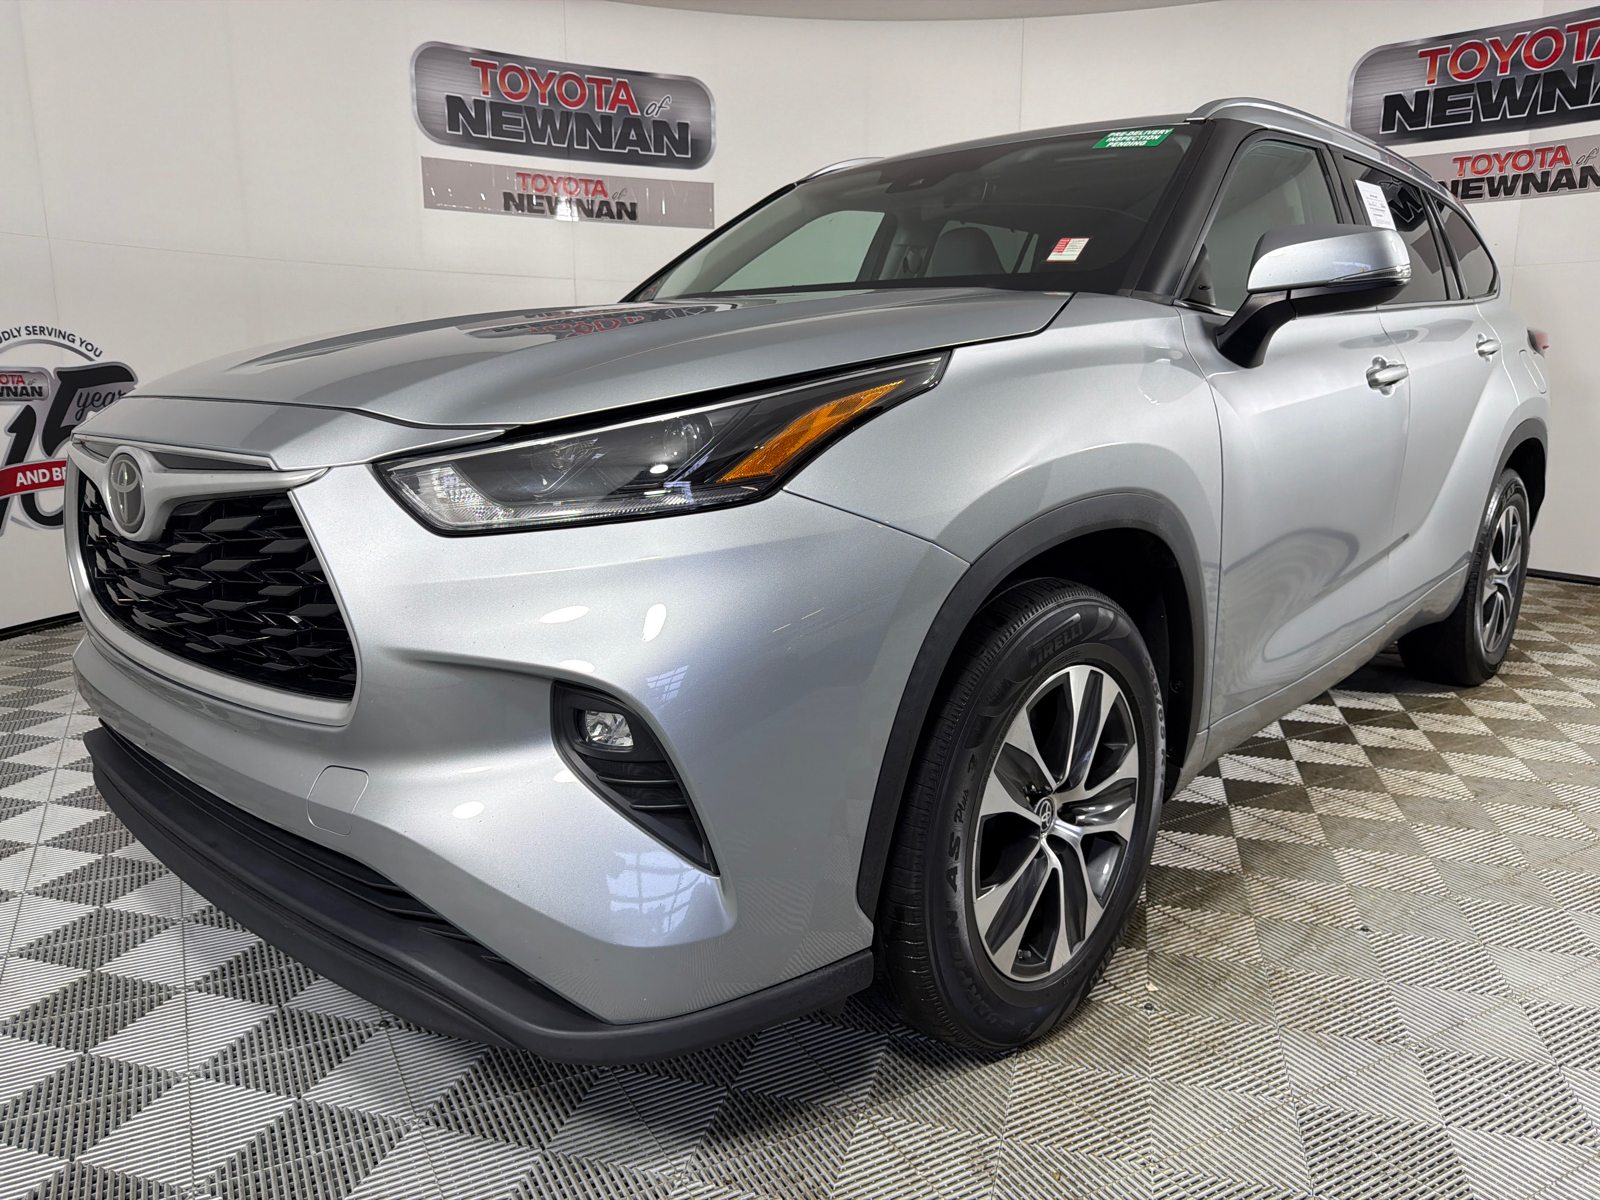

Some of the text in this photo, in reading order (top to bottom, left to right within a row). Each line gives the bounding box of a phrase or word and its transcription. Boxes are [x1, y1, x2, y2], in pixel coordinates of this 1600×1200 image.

[1417, 17, 1600, 87] TOYOT
[469, 57, 672, 119] TOYOTA of
[1379, 63, 1600, 135] NEWN
[445, 93, 693, 158] NEWNAN
[1105, 134, 1162, 143] INSPECTION
[1107, 128, 1171, 138] PRE-DELIVERY
[1105, 140, 1148, 148] PENDING
[1453, 145, 1599, 177] TOYOTA of
[515, 172, 628, 200] TOYOTA of
[24, 325, 76, 344] SERVING
[78, 337, 103, 358] YOU
[27, 378, 37, 386] of
[16, 468, 51, 487] AND
[1025, 613, 1084, 669] PIRELLI
[947, 833, 961, 893] AS
[954, 788, 971, 824] Plus
